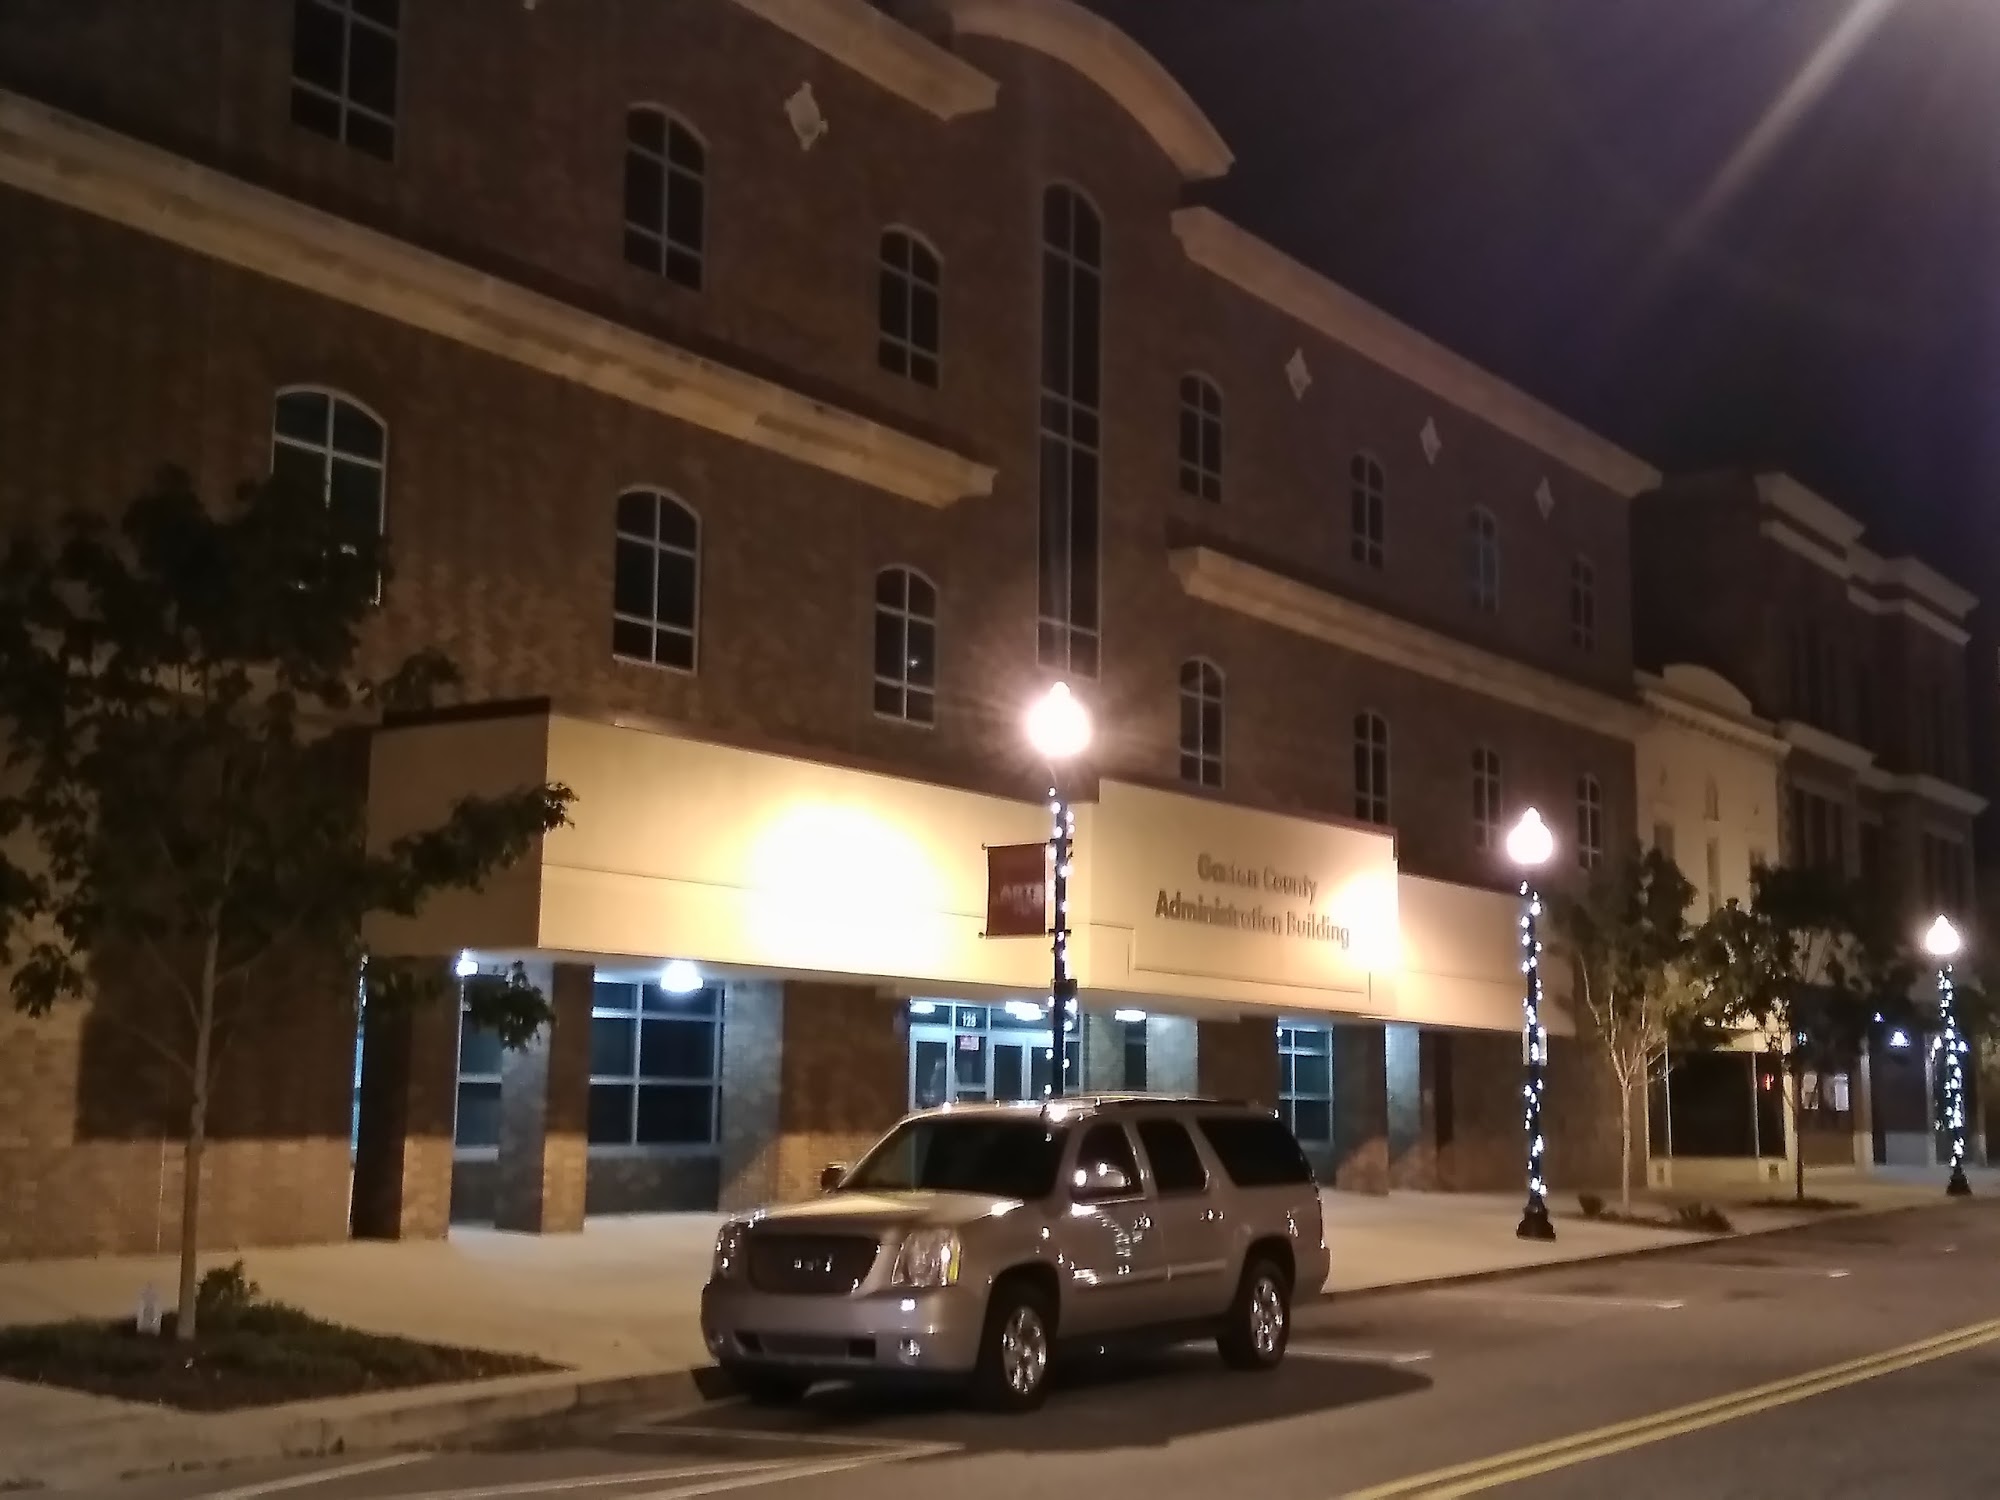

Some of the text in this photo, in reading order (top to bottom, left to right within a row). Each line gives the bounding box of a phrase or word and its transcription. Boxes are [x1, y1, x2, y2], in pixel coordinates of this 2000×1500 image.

[1263, 865, 1318, 905] County
[1155, 889, 1350, 949] Administration Building
